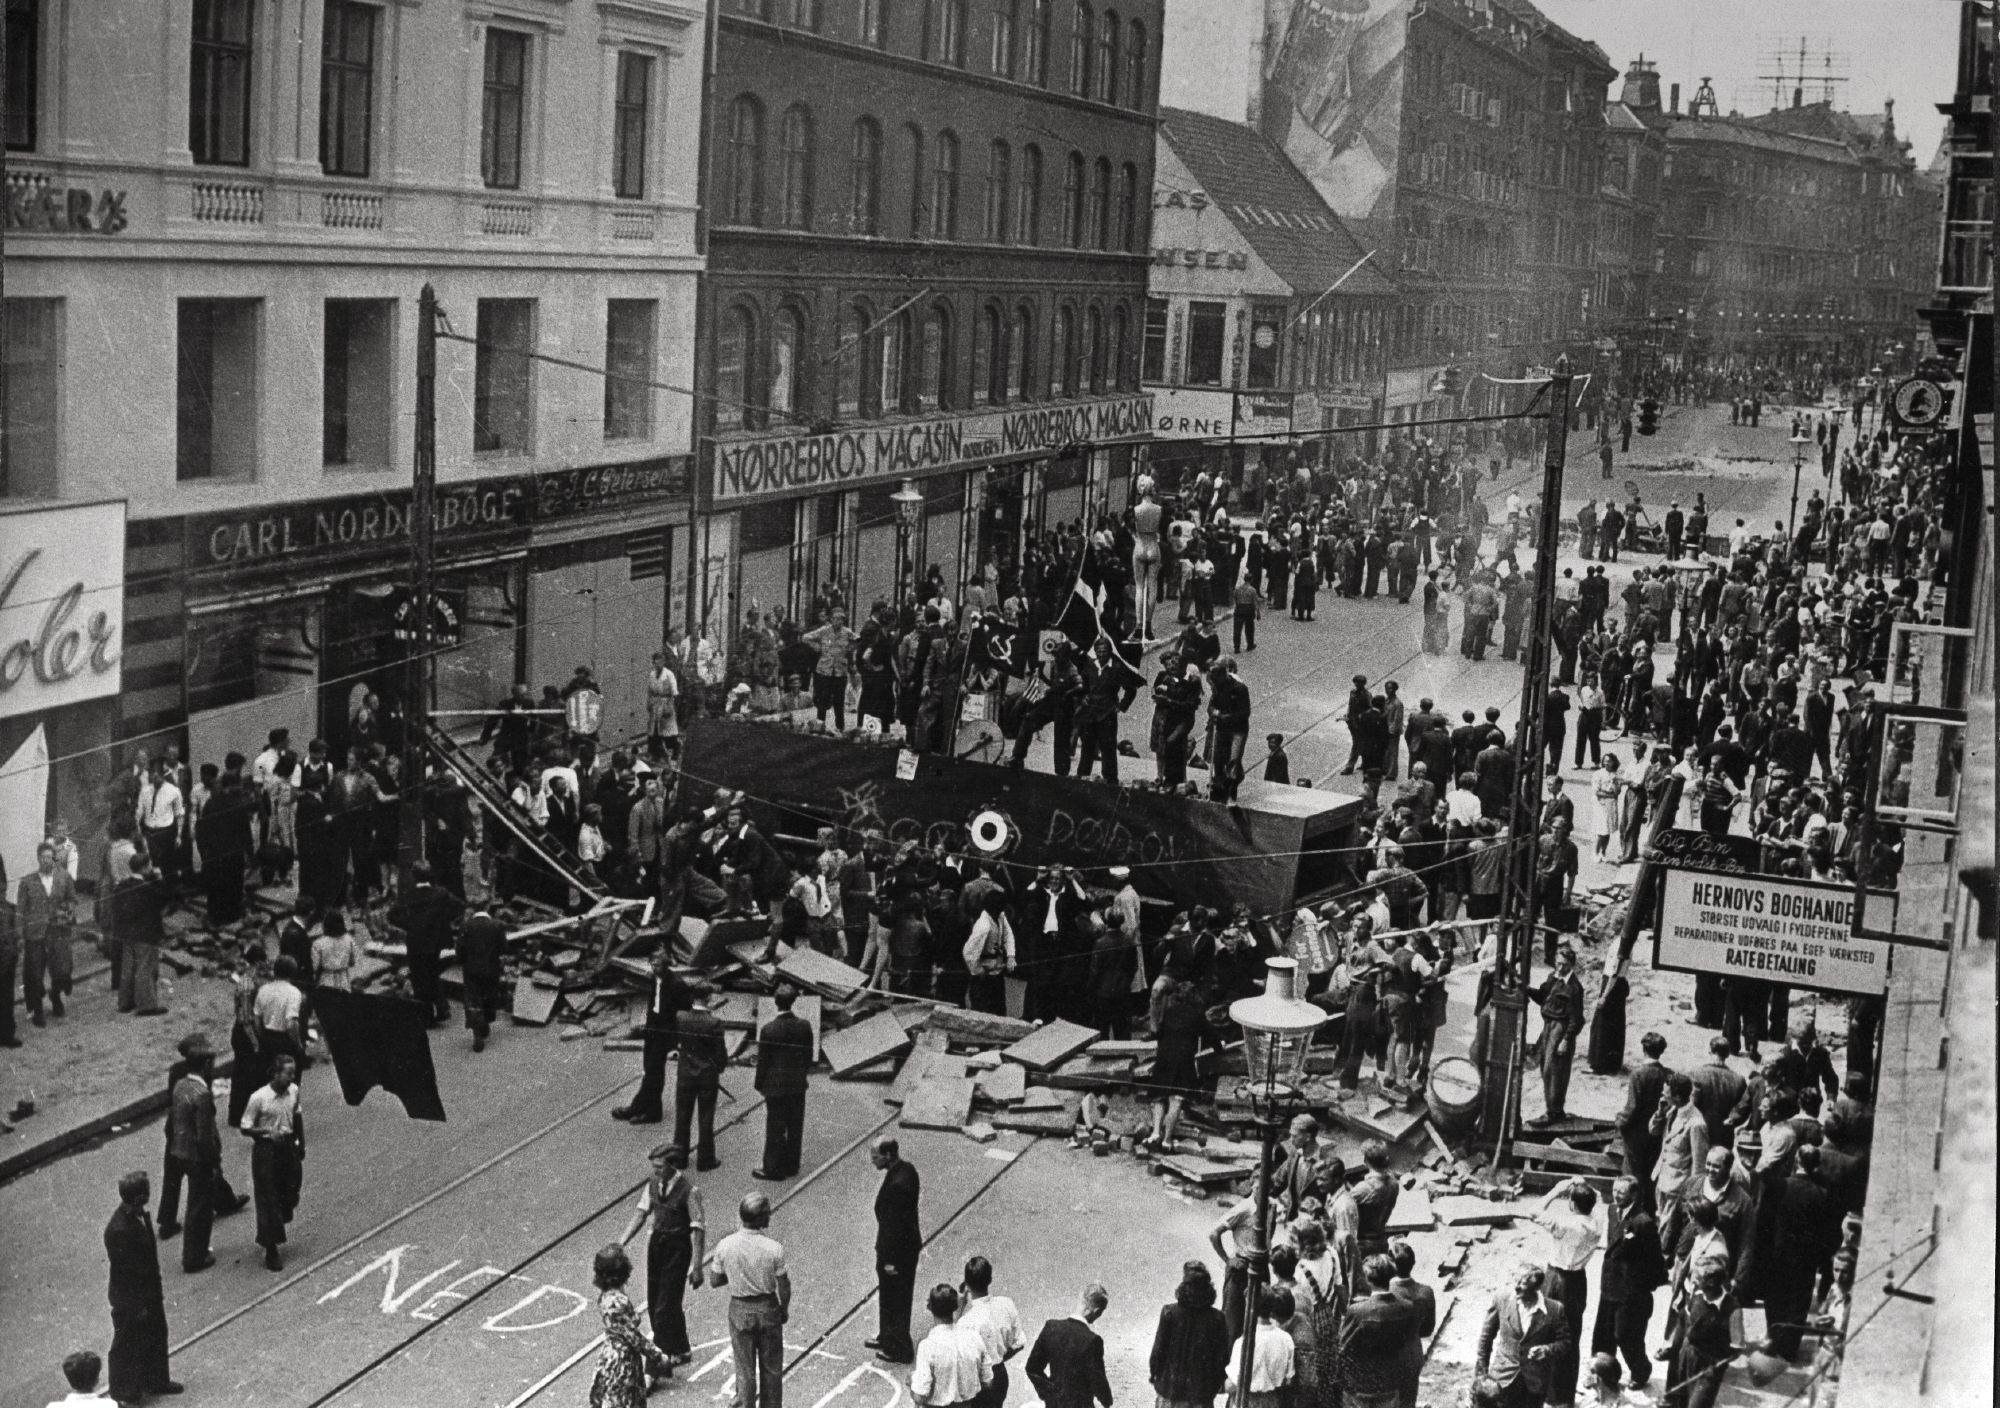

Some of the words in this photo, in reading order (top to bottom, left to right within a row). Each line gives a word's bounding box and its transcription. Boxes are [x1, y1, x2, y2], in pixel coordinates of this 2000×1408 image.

[1002, 406, 1092, 453] NØRREBROS
[1097, 400, 1154, 438] MAGASIN
[720, 431, 866, 495] NØRREBROS
[875, 421, 963, 473] MAGASIN
[210, 518, 298, 561] CARL
[1692, 882, 1765, 914] HERNOVS
[1770, 892, 1854, 925] BOGHANDE
[1674, 926, 1735, 944] REPARATIONER
[1738, 935, 1777, 951] UDFØRES
[1781, 940, 1798, 954] PAA
[1829, 946, 1875, 964] VÆRKSTED
[1700, 911, 1739, 928] STØRSTE
[1741, 916, 1780, 934] UDVALG
[1782, 922, 1787, 934] I
[1789, 922, 1849, 943] FYLDEPENNE
[1726, 948, 1816, 976] RATEBETALING
[317, 1243, 589, 1332] NED
